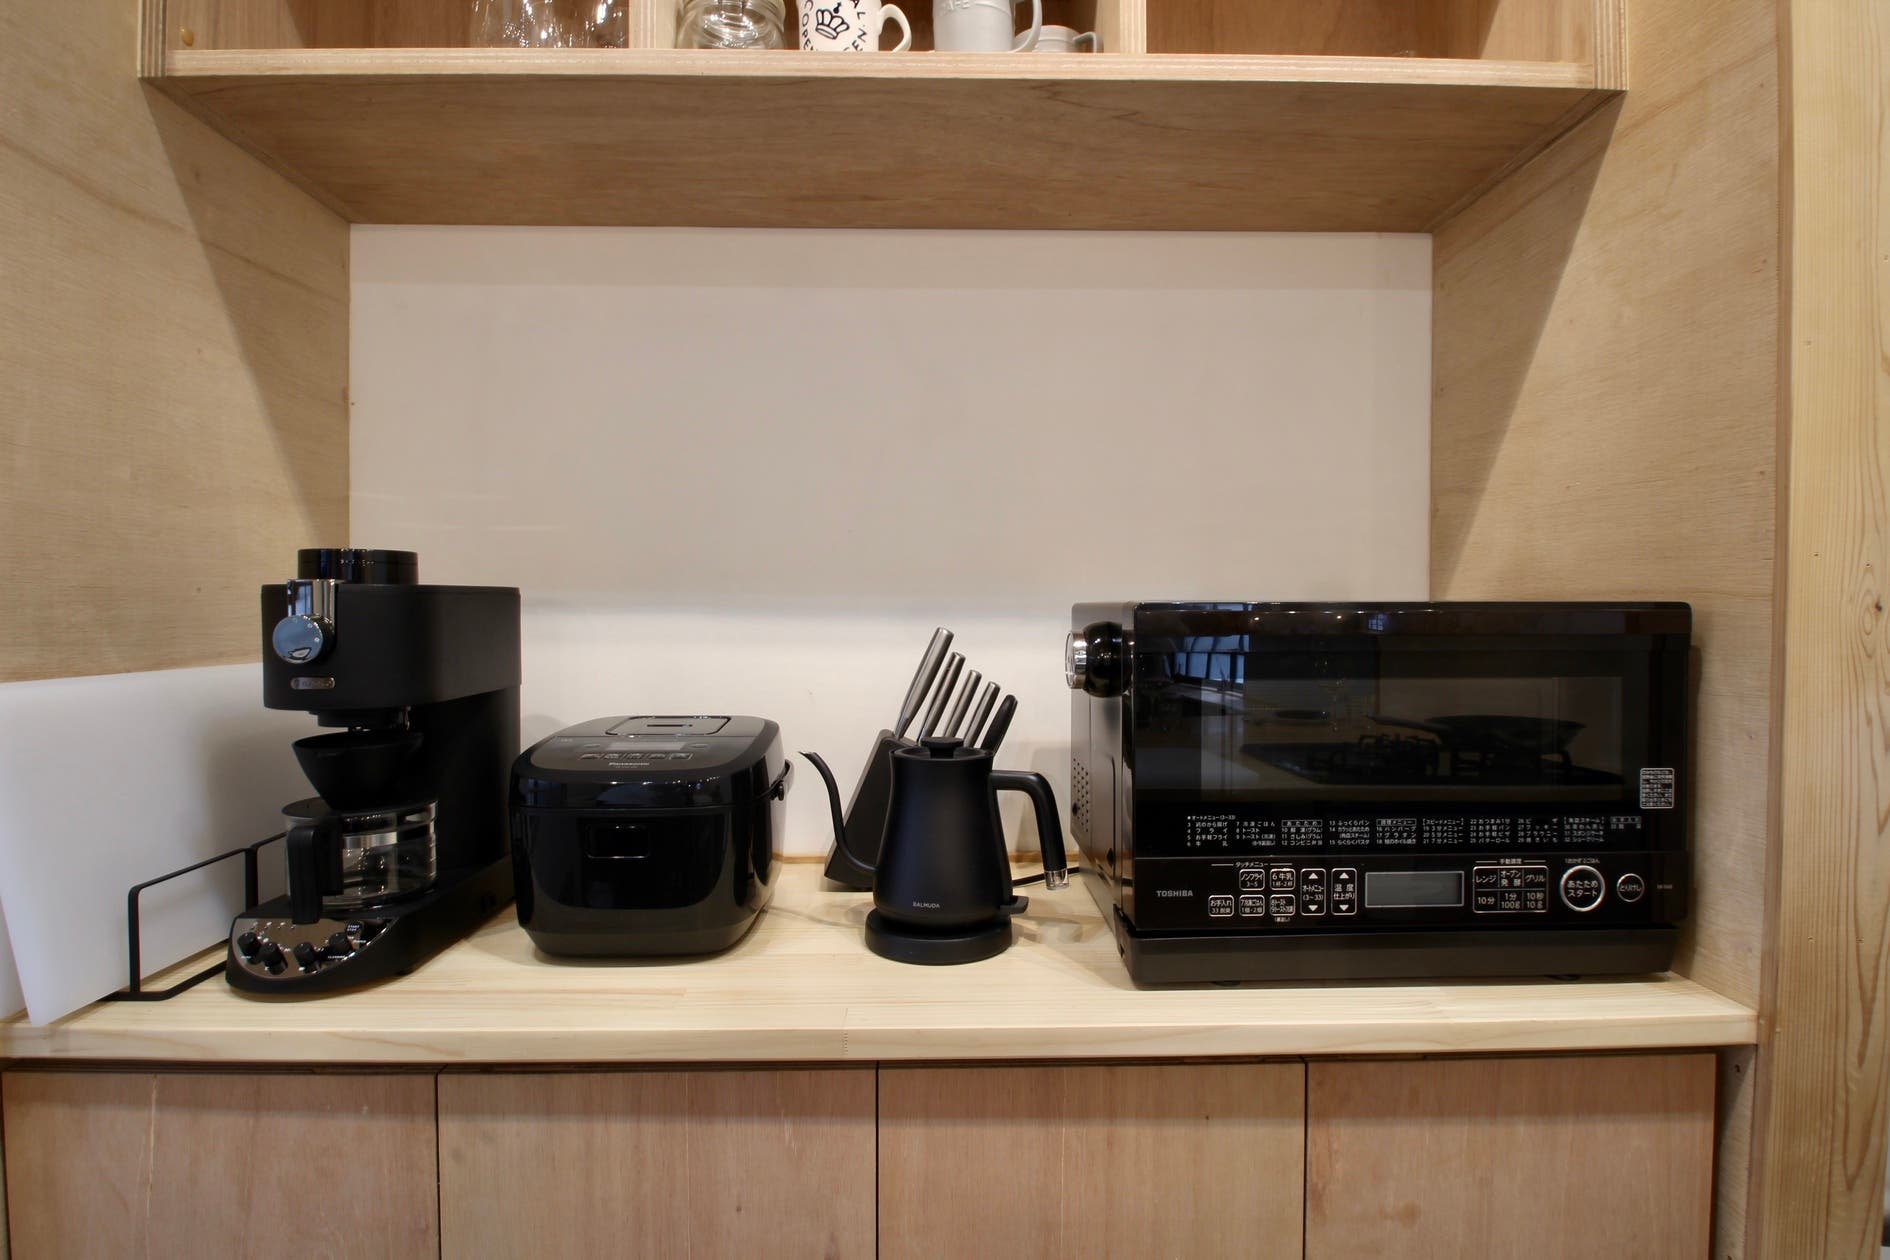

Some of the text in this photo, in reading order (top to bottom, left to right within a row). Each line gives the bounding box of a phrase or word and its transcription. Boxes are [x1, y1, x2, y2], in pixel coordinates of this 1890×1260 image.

[1240, 873, 1264, 881] ノンフライ
[1500, 870, 1521, 878] オープン
[1475, 875, 1497, 883] レンジ
[1524, 875, 1545, 883] グリル
[1567, 880, 1599, 889] あたため
[1619, 884, 1642, 892] とりけし
[1333, 892, 1355, 900] 仕上がり
[1504, 893, 1517, 901] 1分
[1526, 893, 1544, 901] 10秒
[1567, 889, 1598, 897] スタート
[912, 900, 940, 909] BALMUDA
[1477, 896, 1495, 905] 10分
